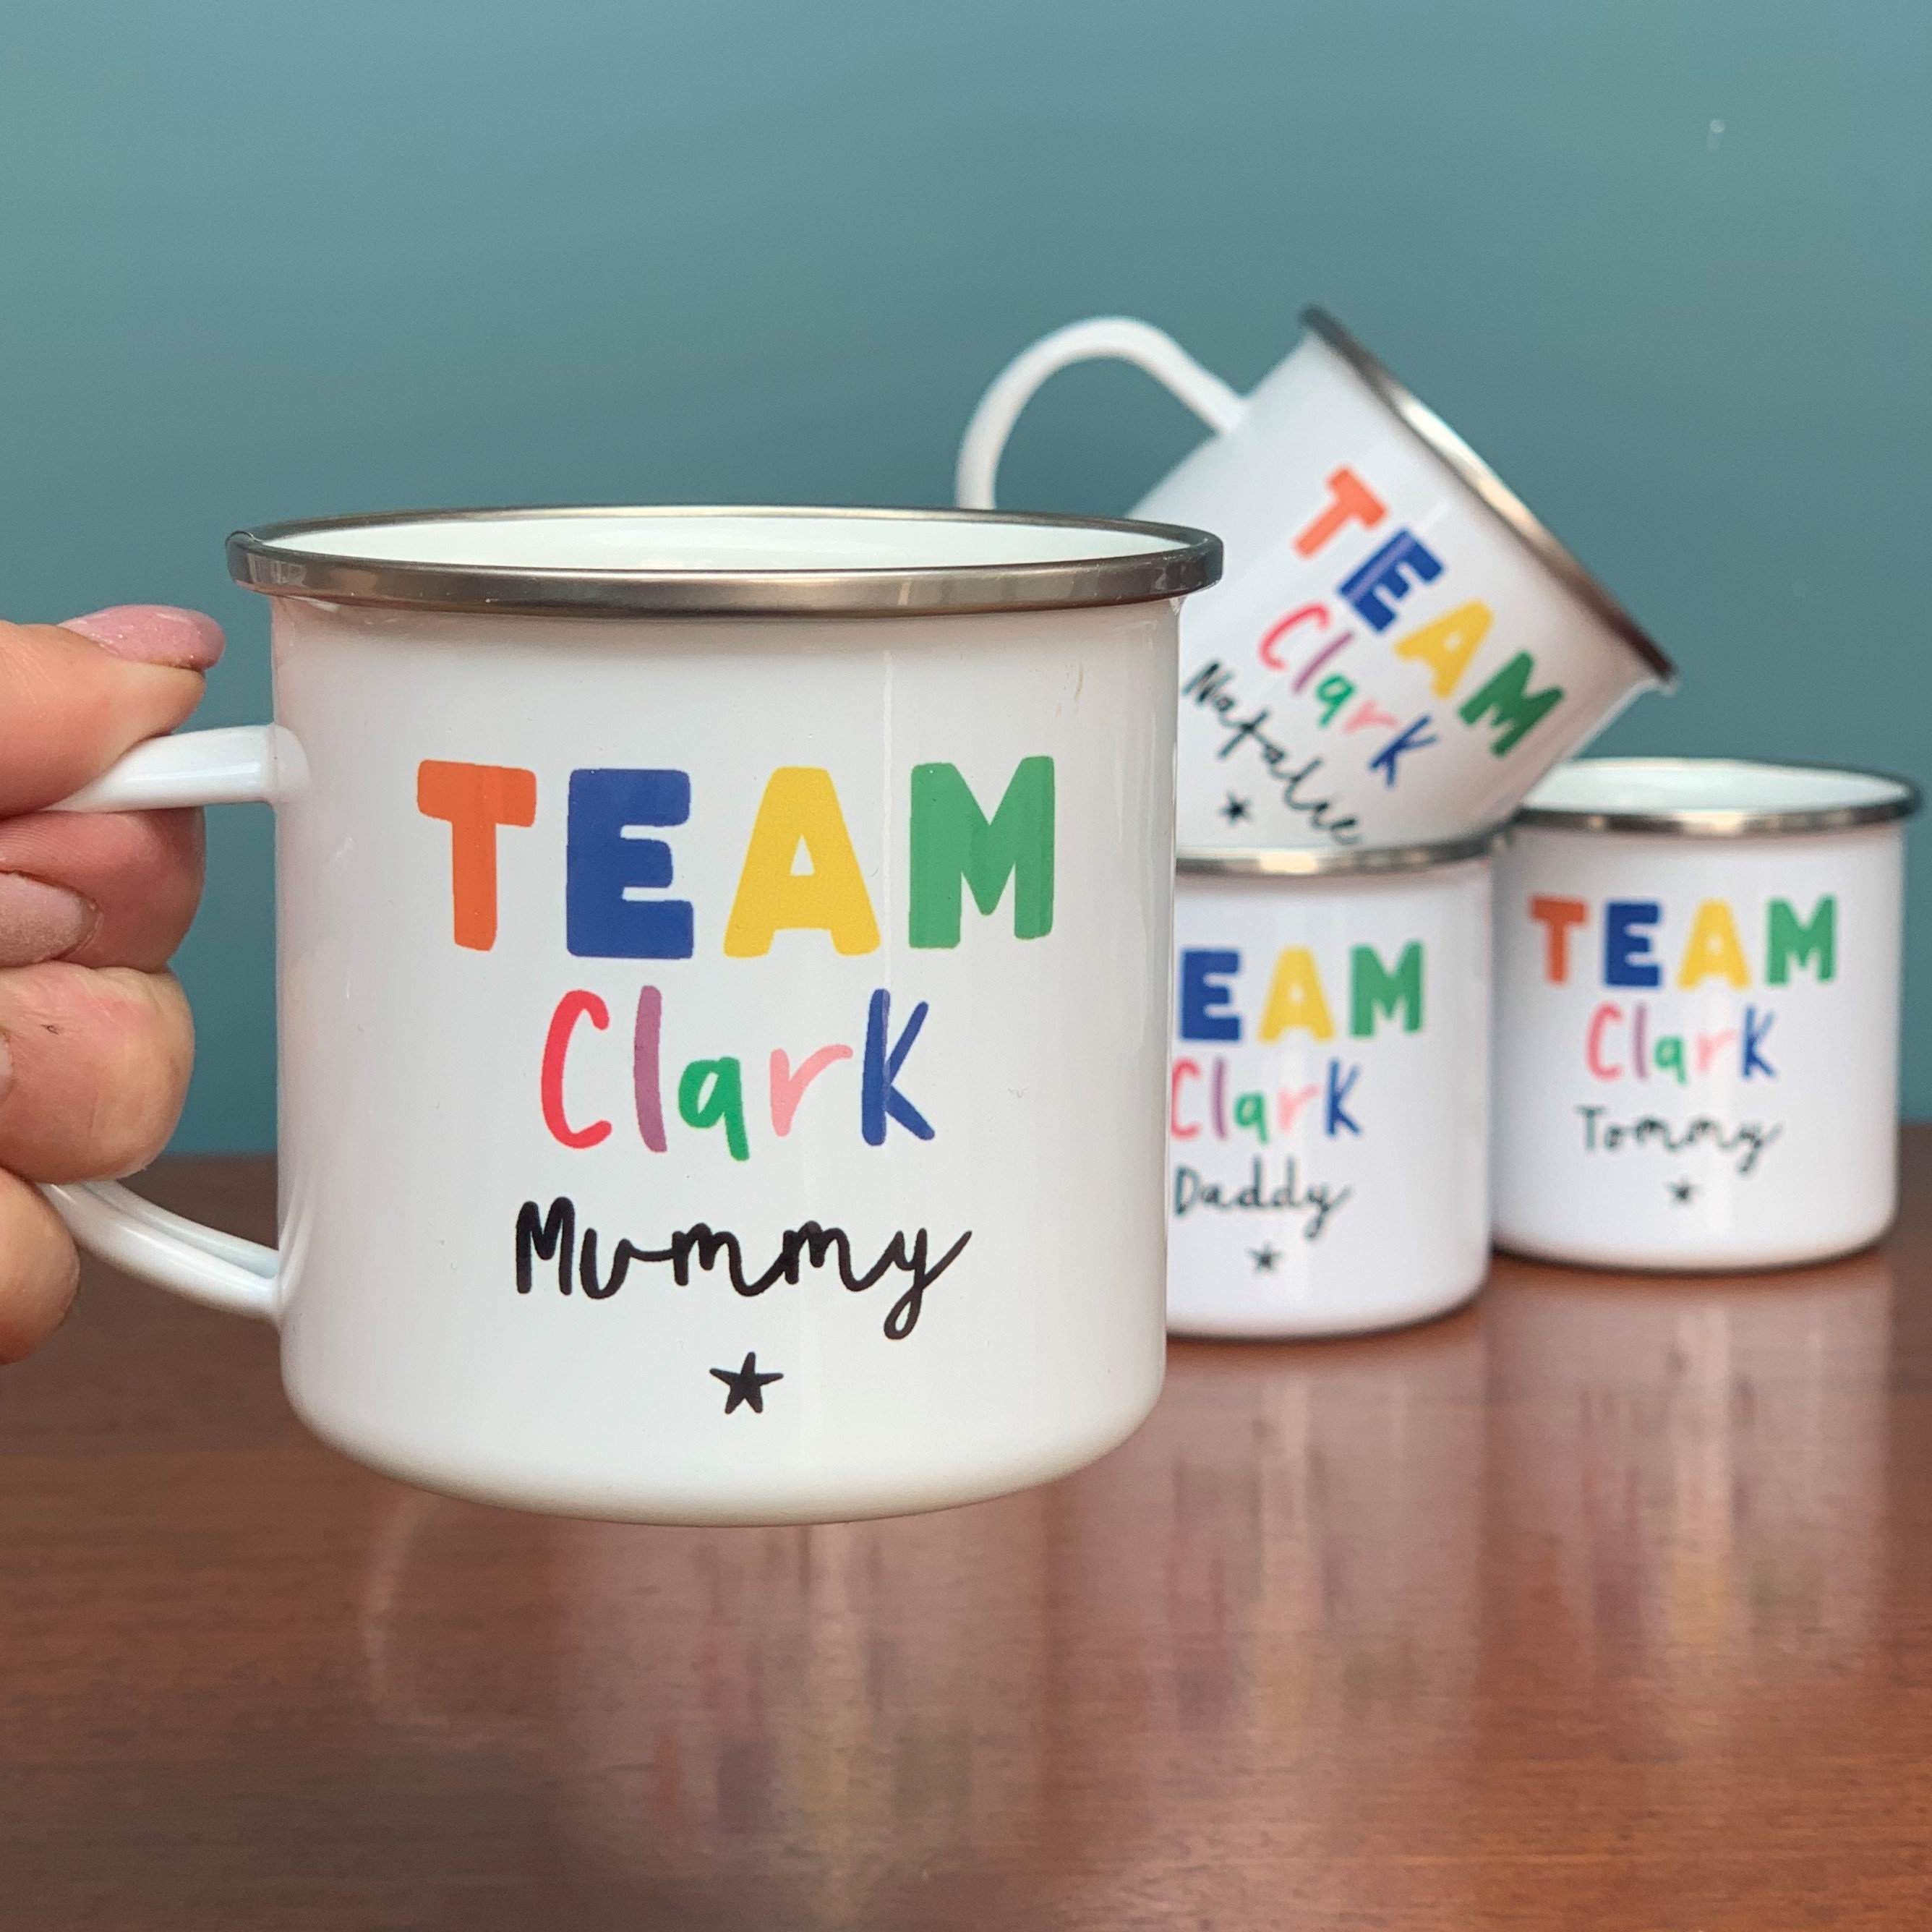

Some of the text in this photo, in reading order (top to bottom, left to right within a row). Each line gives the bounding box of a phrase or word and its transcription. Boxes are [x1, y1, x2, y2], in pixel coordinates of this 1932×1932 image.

[1291, 460, 1566, 759] TEAM
[416, 755, 1056, 959] TEAM
[1179, 939, 1426, 1045] EAM
[1527, 892, 1838, 991] TEAM
[1573, 1103, 1784, 1176] Tommy
[1173, 1153, 1354, 1241] Daddy
[515, 1196, 973, 1341] Mummy
